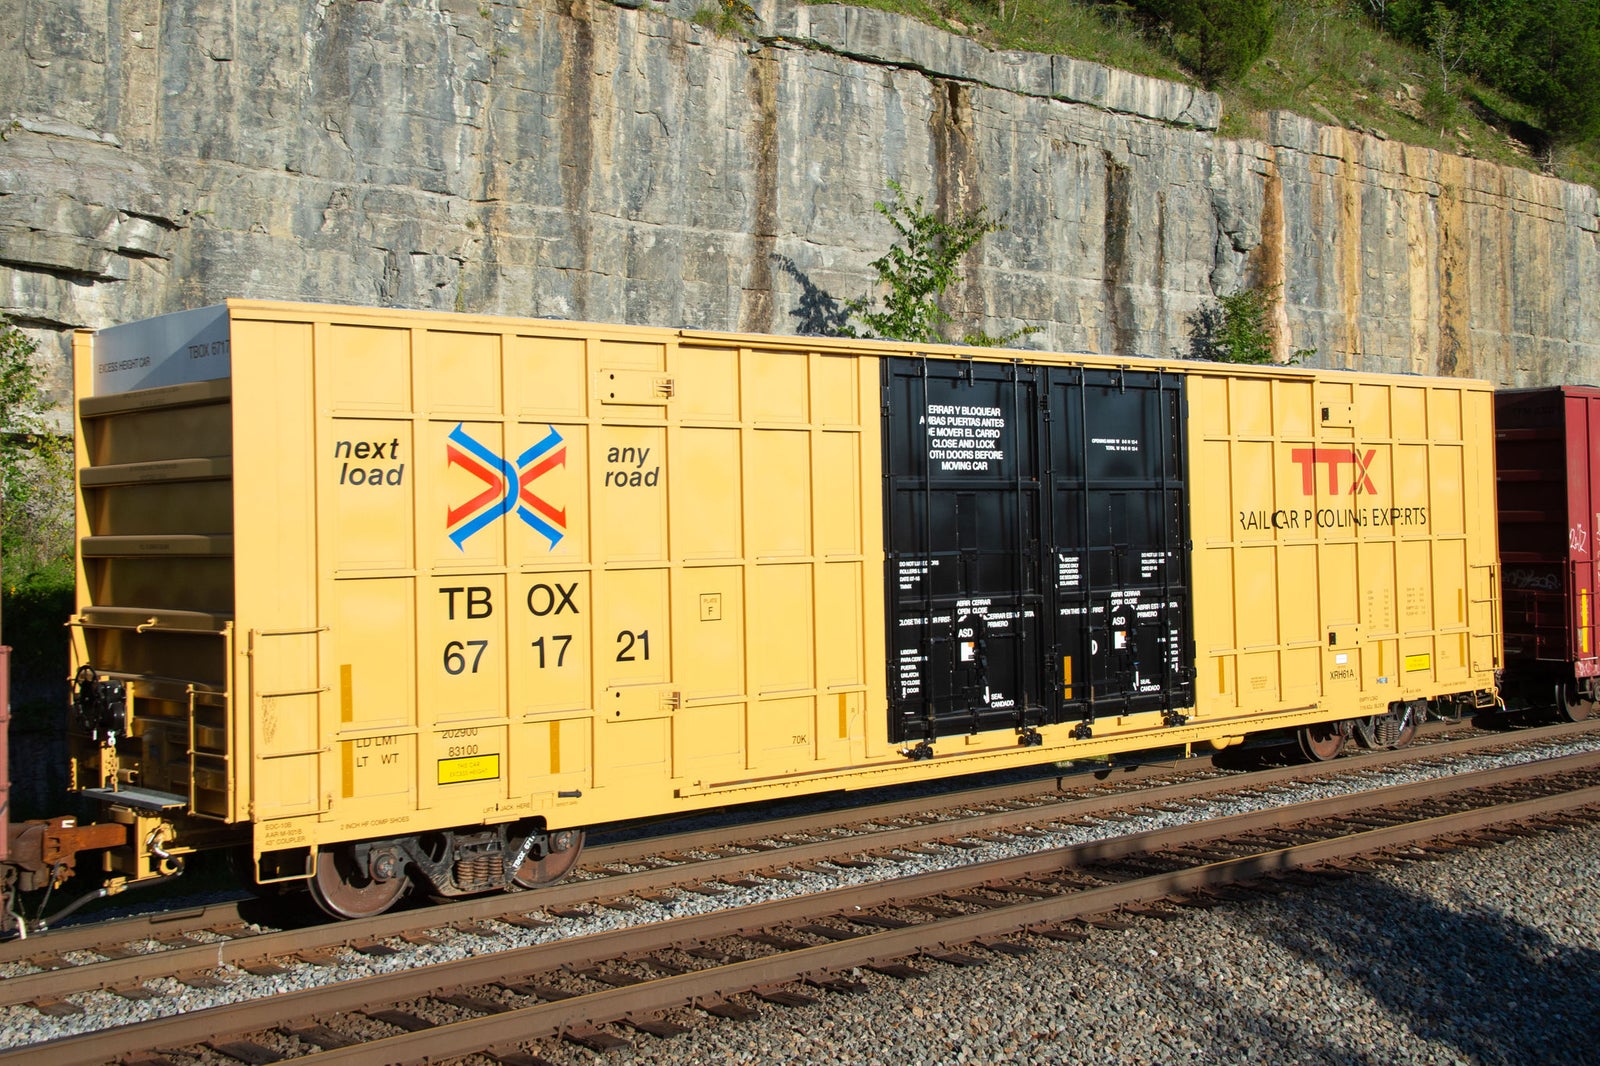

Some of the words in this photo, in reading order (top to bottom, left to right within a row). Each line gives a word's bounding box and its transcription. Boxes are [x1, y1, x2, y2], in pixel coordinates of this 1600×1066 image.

[188, 343, 210, 360] TBOX
[98, 362, 118, 374] EXCESS
[139, 356, 151, 367] CAR
[928, 404, 954, 415] ERRAR
[954, 405, 960, 415] Y
[961, 406, 1001, 417] BLOQUEAR
[947, 416, 981, 427] PUERTAS
[981, 418, 1005, 428] ANTES
[936, 427, 964, 437] MOVER
[964, 428, 974, 437] EL
[975, 428, 1000, 438] CARRO
[334, 438, 399, 461] next
[932, 439, 958, 448] CLOSE
[958, 439, 974, 448] AND
[975, 439, 996, 449] LOCK
[606, 446, 651, 469] any
[929, 450, 945, 459] OTH
[946, 450, 974, 459] DOORS
[974, 450, 1004, 460] BEFORE
[941, 461, 972, 471] MOVING
[972, 461, 988, 471] CAR
[339, 463, 405, 487] load
[604, 467, 660, 487] road
[1291, 448, 1378, 496] TTX
[708, 606, 714, 616] F
[1112, 617, 1126, 625] ASD
[957, 629, 973, 638] ASD
[615, 629, 651, 663] 21
[1329, 669, 1355, 680] XRH61A
[991, 700, 1014, 708] CANDADO
[442, 728, 478, 739] 202900
[356, 738, 372, 748] LD
[375, 735, 397, 746] LMT
[792, 735, 807, 744] 70K
[449, 744, 479, 757] 83100
[356, 756, 369, 767] LT
[381, 753, 399, 764] WT
[516, 802, 530, 810] HERE
[370, 818, 388, 826] COMP
[389, 816, 410, 824] SHOES
[276, 836, 306, 845] COUPLER
[512, 850, 527, 869] TBOX
